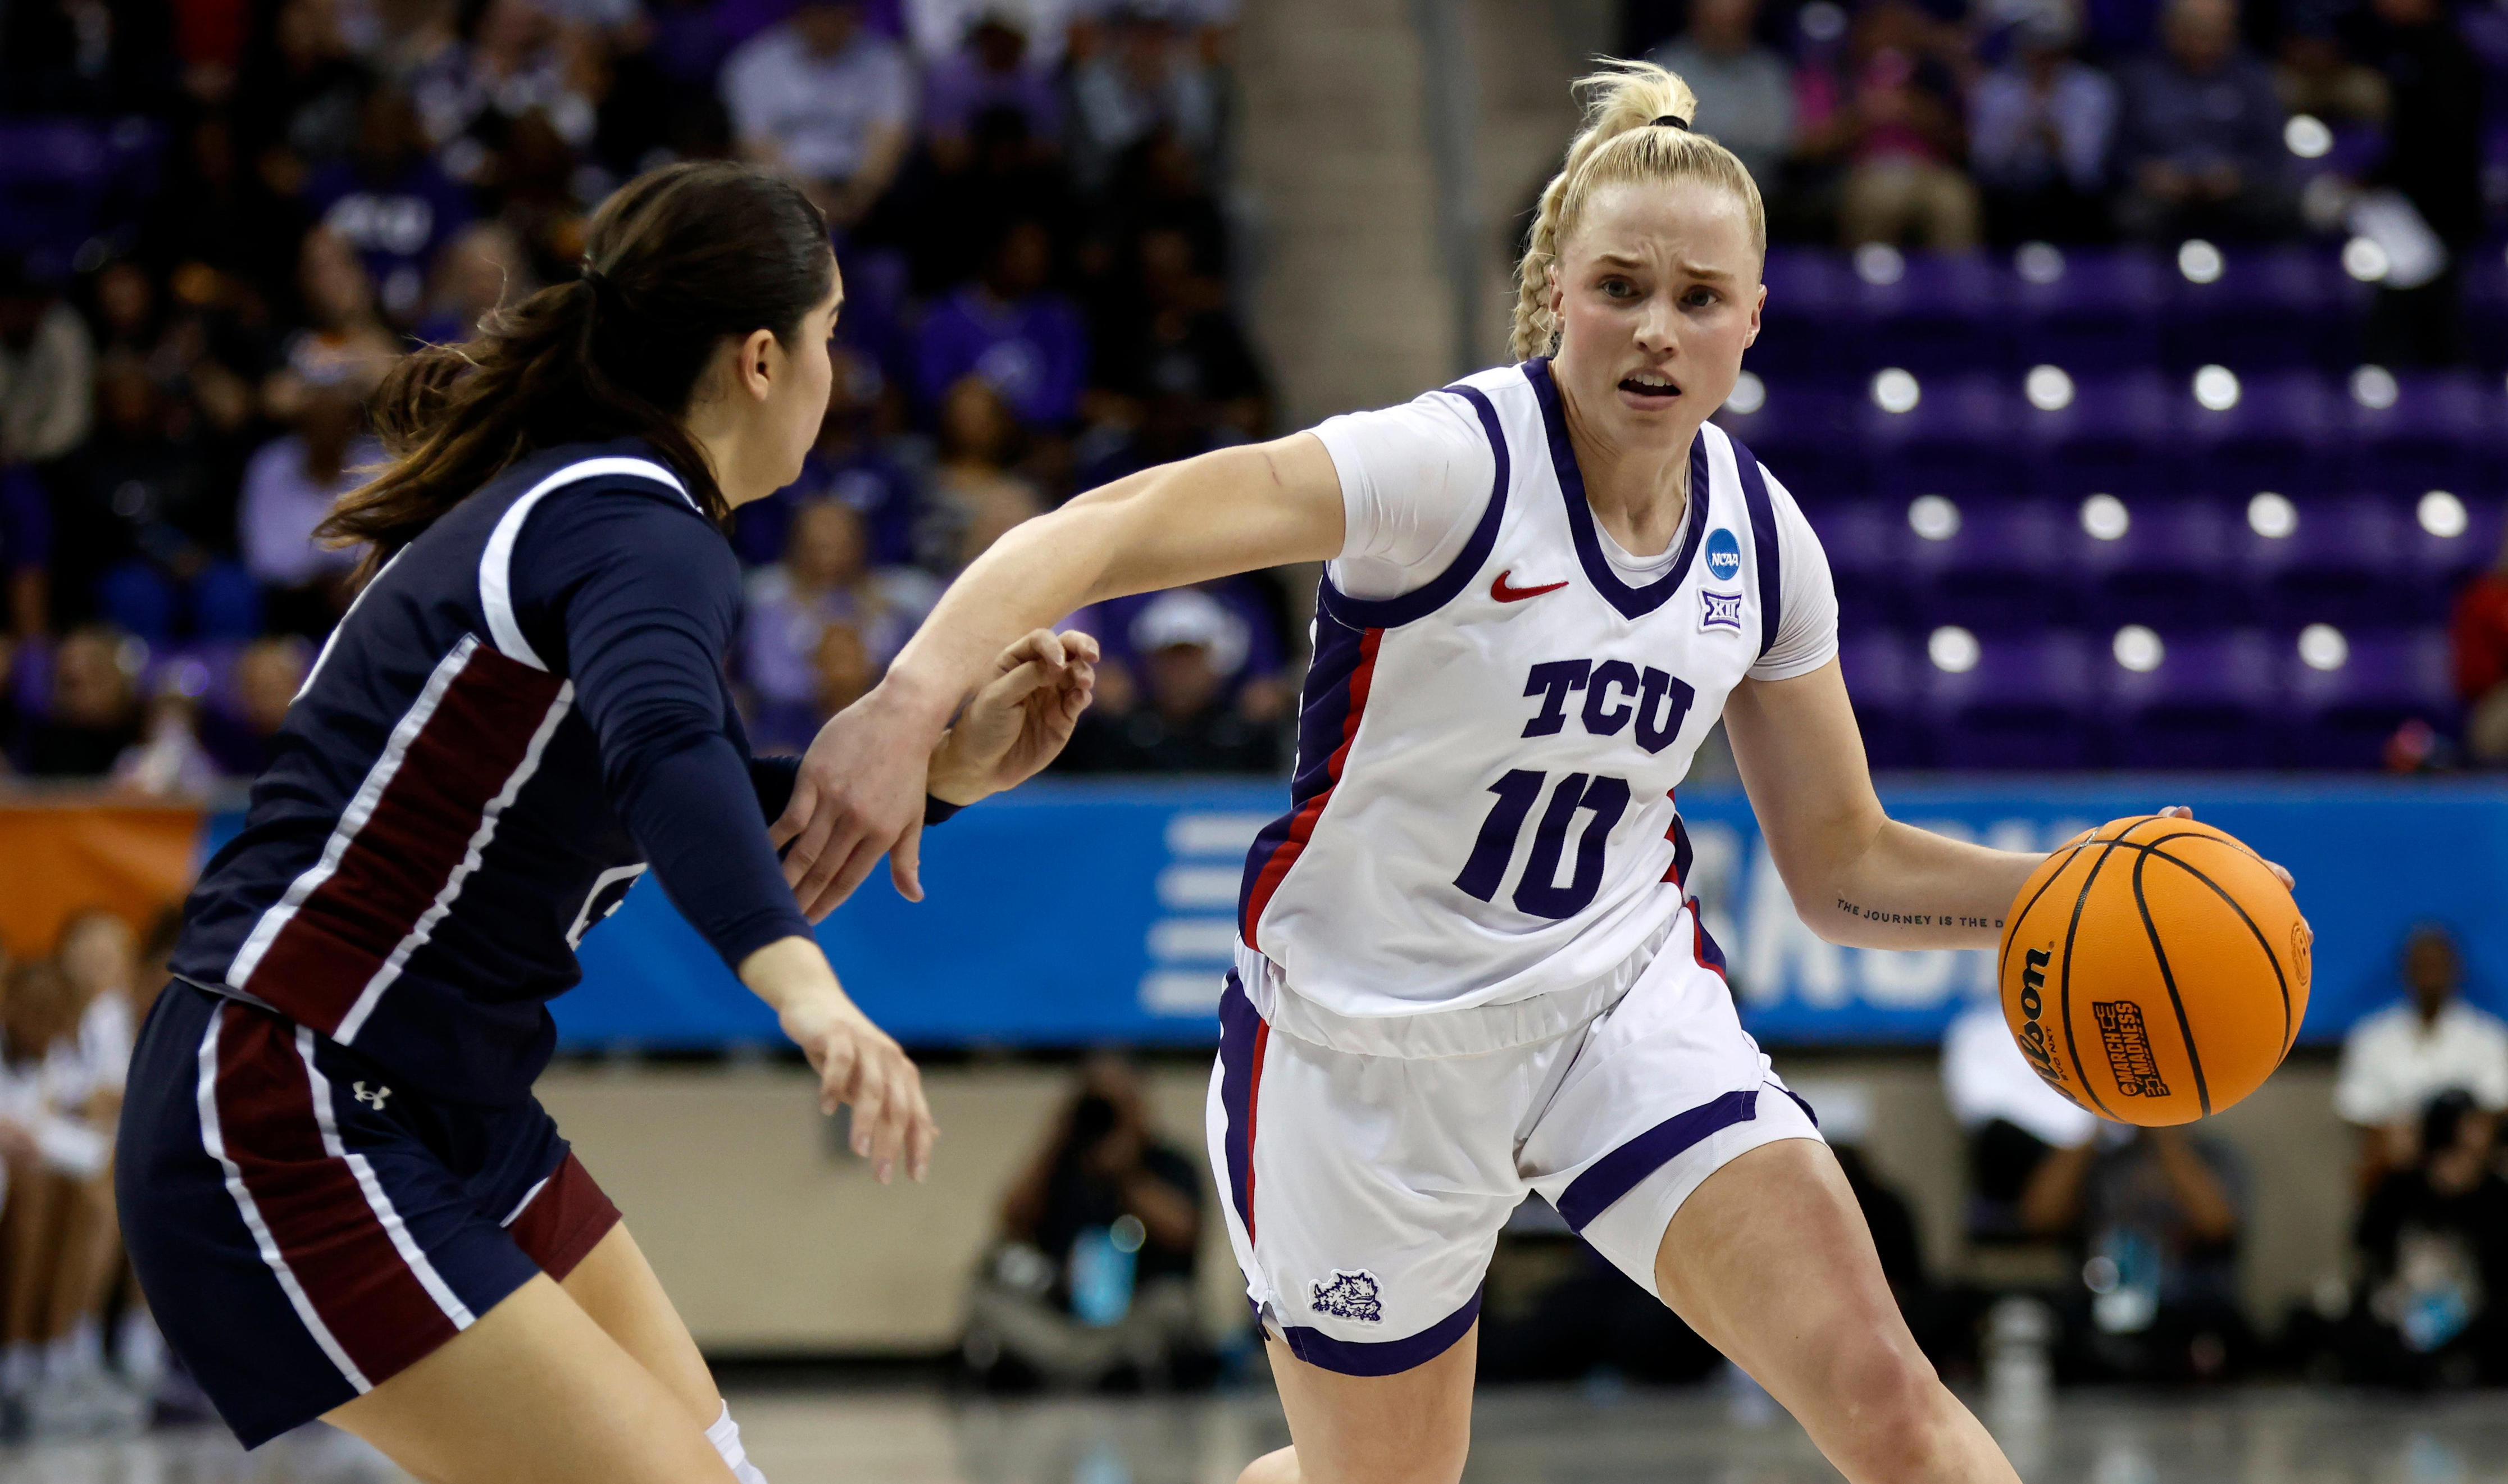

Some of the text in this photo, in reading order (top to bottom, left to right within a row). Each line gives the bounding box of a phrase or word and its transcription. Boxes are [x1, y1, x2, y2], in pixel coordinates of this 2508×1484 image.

[1712, 553, 1739, 567] NCAA
[1707, 596, 1740, 625] XII
[1521, 659, 1695, 754] TCU
[1452, 768, 1631, 919] 10
[1837, 899, 1859, 916] THE
[1863, 909, 1931, 926] JOURNEY
[1939, 916, 1952, 926] IS
[1959, 917, 1987, 928] THE
[2046, 1026, 2056, 1053] NXT
[2104, 1032, 2135, 1083] MARCH
[2115, 1003, 2151, 1075] MADNESS
